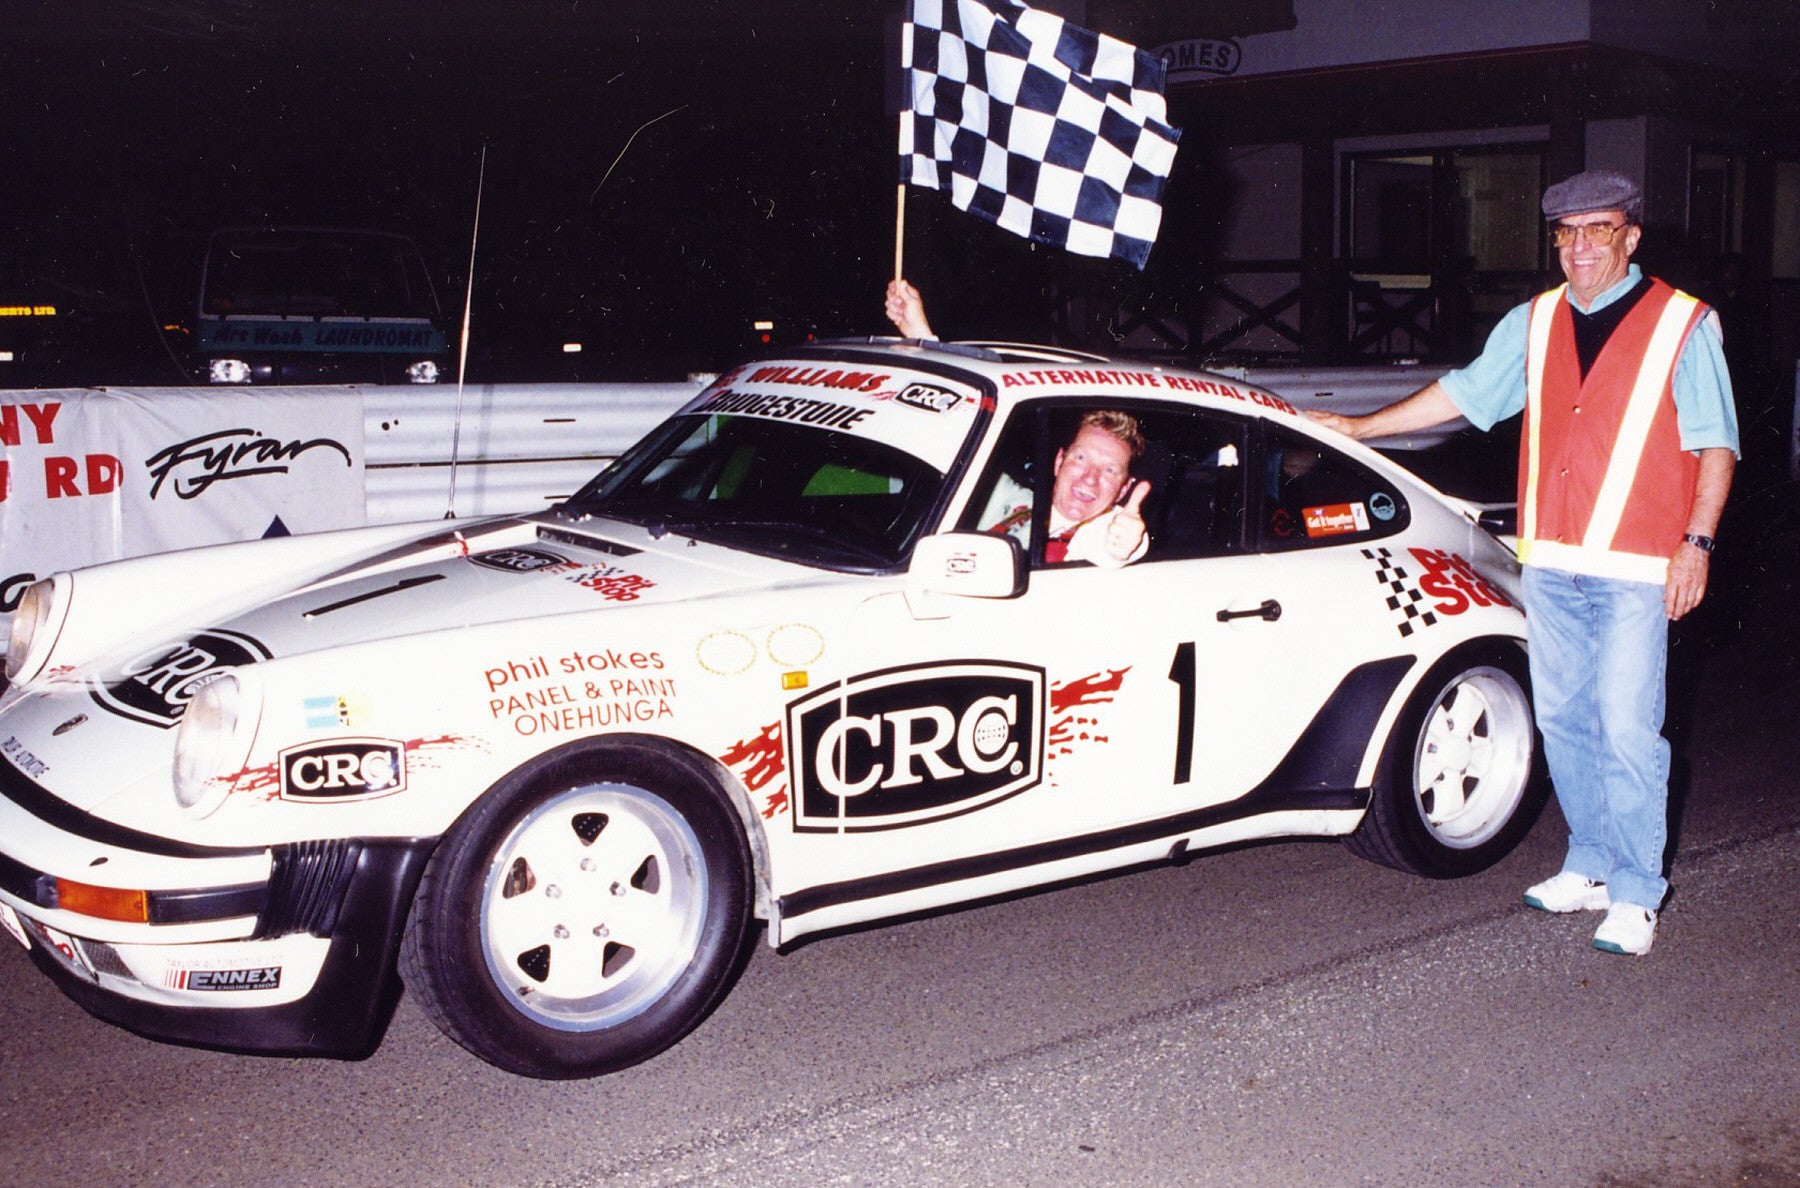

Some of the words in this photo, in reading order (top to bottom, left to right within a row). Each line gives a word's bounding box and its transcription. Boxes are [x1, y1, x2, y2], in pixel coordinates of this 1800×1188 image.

[315, 328, 432, 347] LAUNDROMAT
[745, 366, 891, 392] WILLIAMS
[901, 385, 958, 410] CRC
[1002, 369, 1161, 388] ALTERNATIVE
[1166, 374, 1246, 401] RENTAL
[1250, 390, 1298, 416] CARS
[702, 389, 876, 430] BRIDGESTONE
[44, 453, 124, 499] RD
[1407, 547, 1490, 586] Pit
[581, 577, 641, 602] Stop
[1418, 570, 1513, 616] Sto
[485, 656, 549, 693] phil
[560, 649, 664, 673] stokes
[489, 685, 577, 719] PANEL
[584, 681, 603, 700] &
[610, 678, 676, 698] PAINT
[515, 699, 674, 736] ONEHUNGA
[1168, 641, 1196, 785] 1
[815, 694, 1018, 797] CRC
[291, 751, 395, 791] CRC
[188, 968, 280, 990] ENNEX
